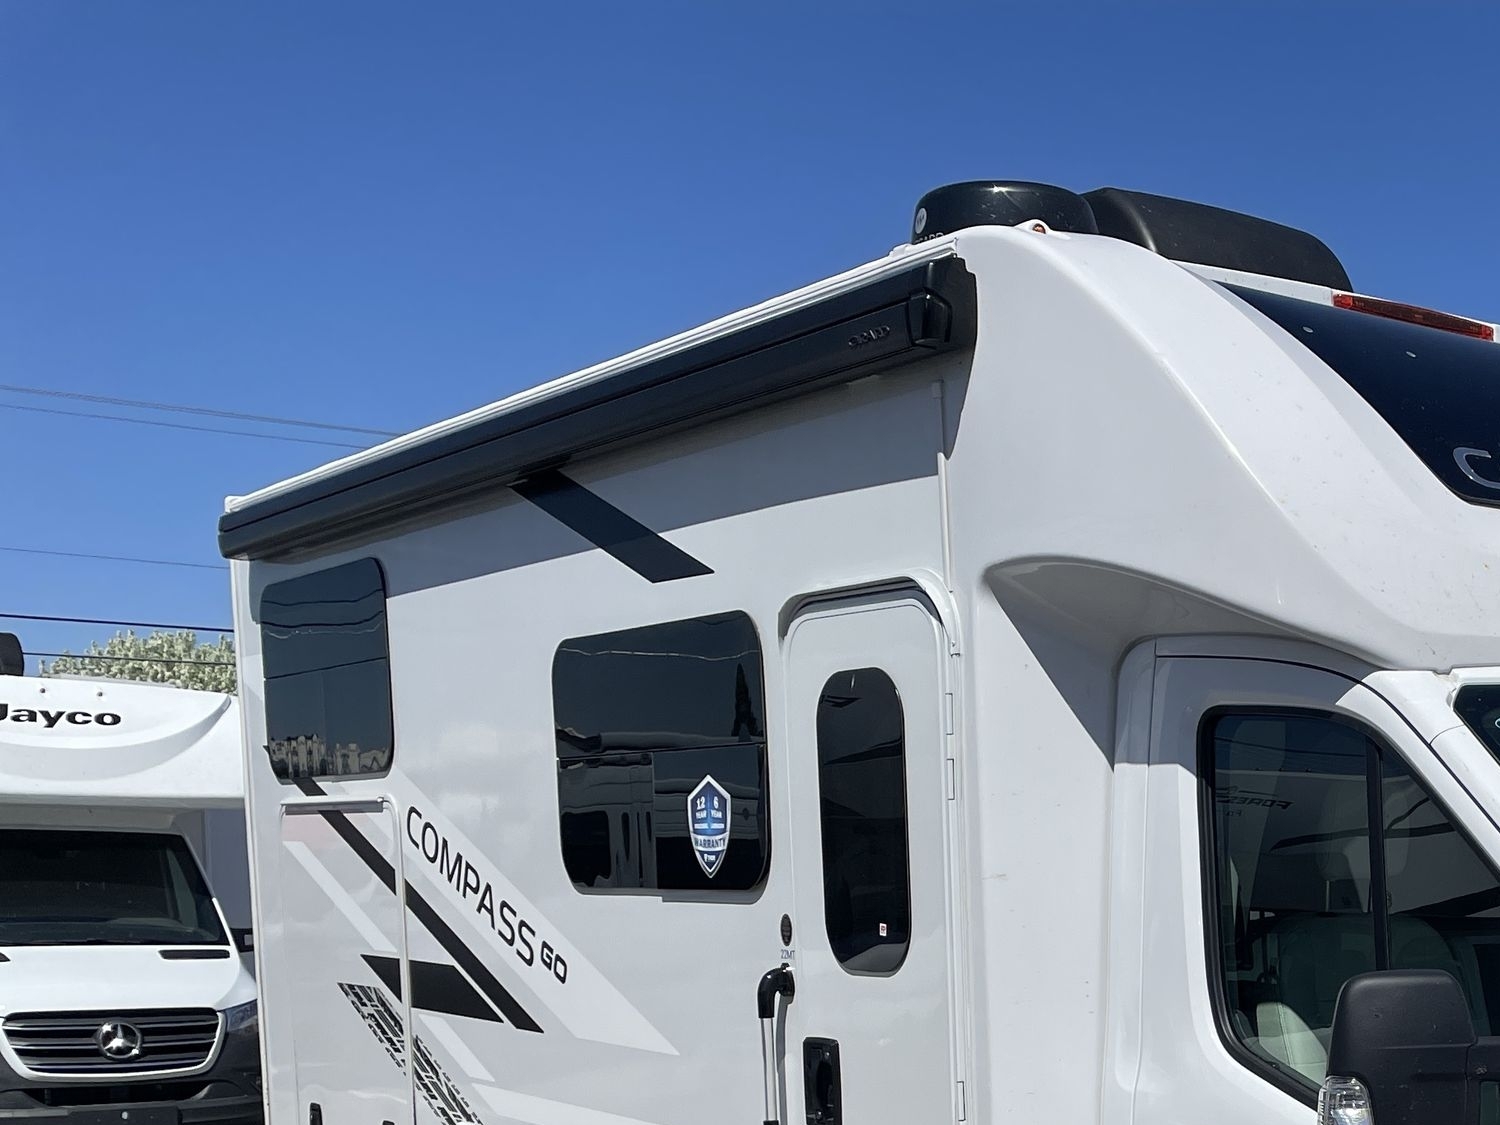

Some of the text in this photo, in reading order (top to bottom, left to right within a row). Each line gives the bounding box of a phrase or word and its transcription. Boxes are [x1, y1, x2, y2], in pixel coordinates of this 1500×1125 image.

[696, 796, 706, 810] 12
[713, 796, 719, 809] 6
[693, 836, 726, 849] WARRANTY
[407, 805, 537, 968] COMPASS
[540, 940, 568, 985] GO
